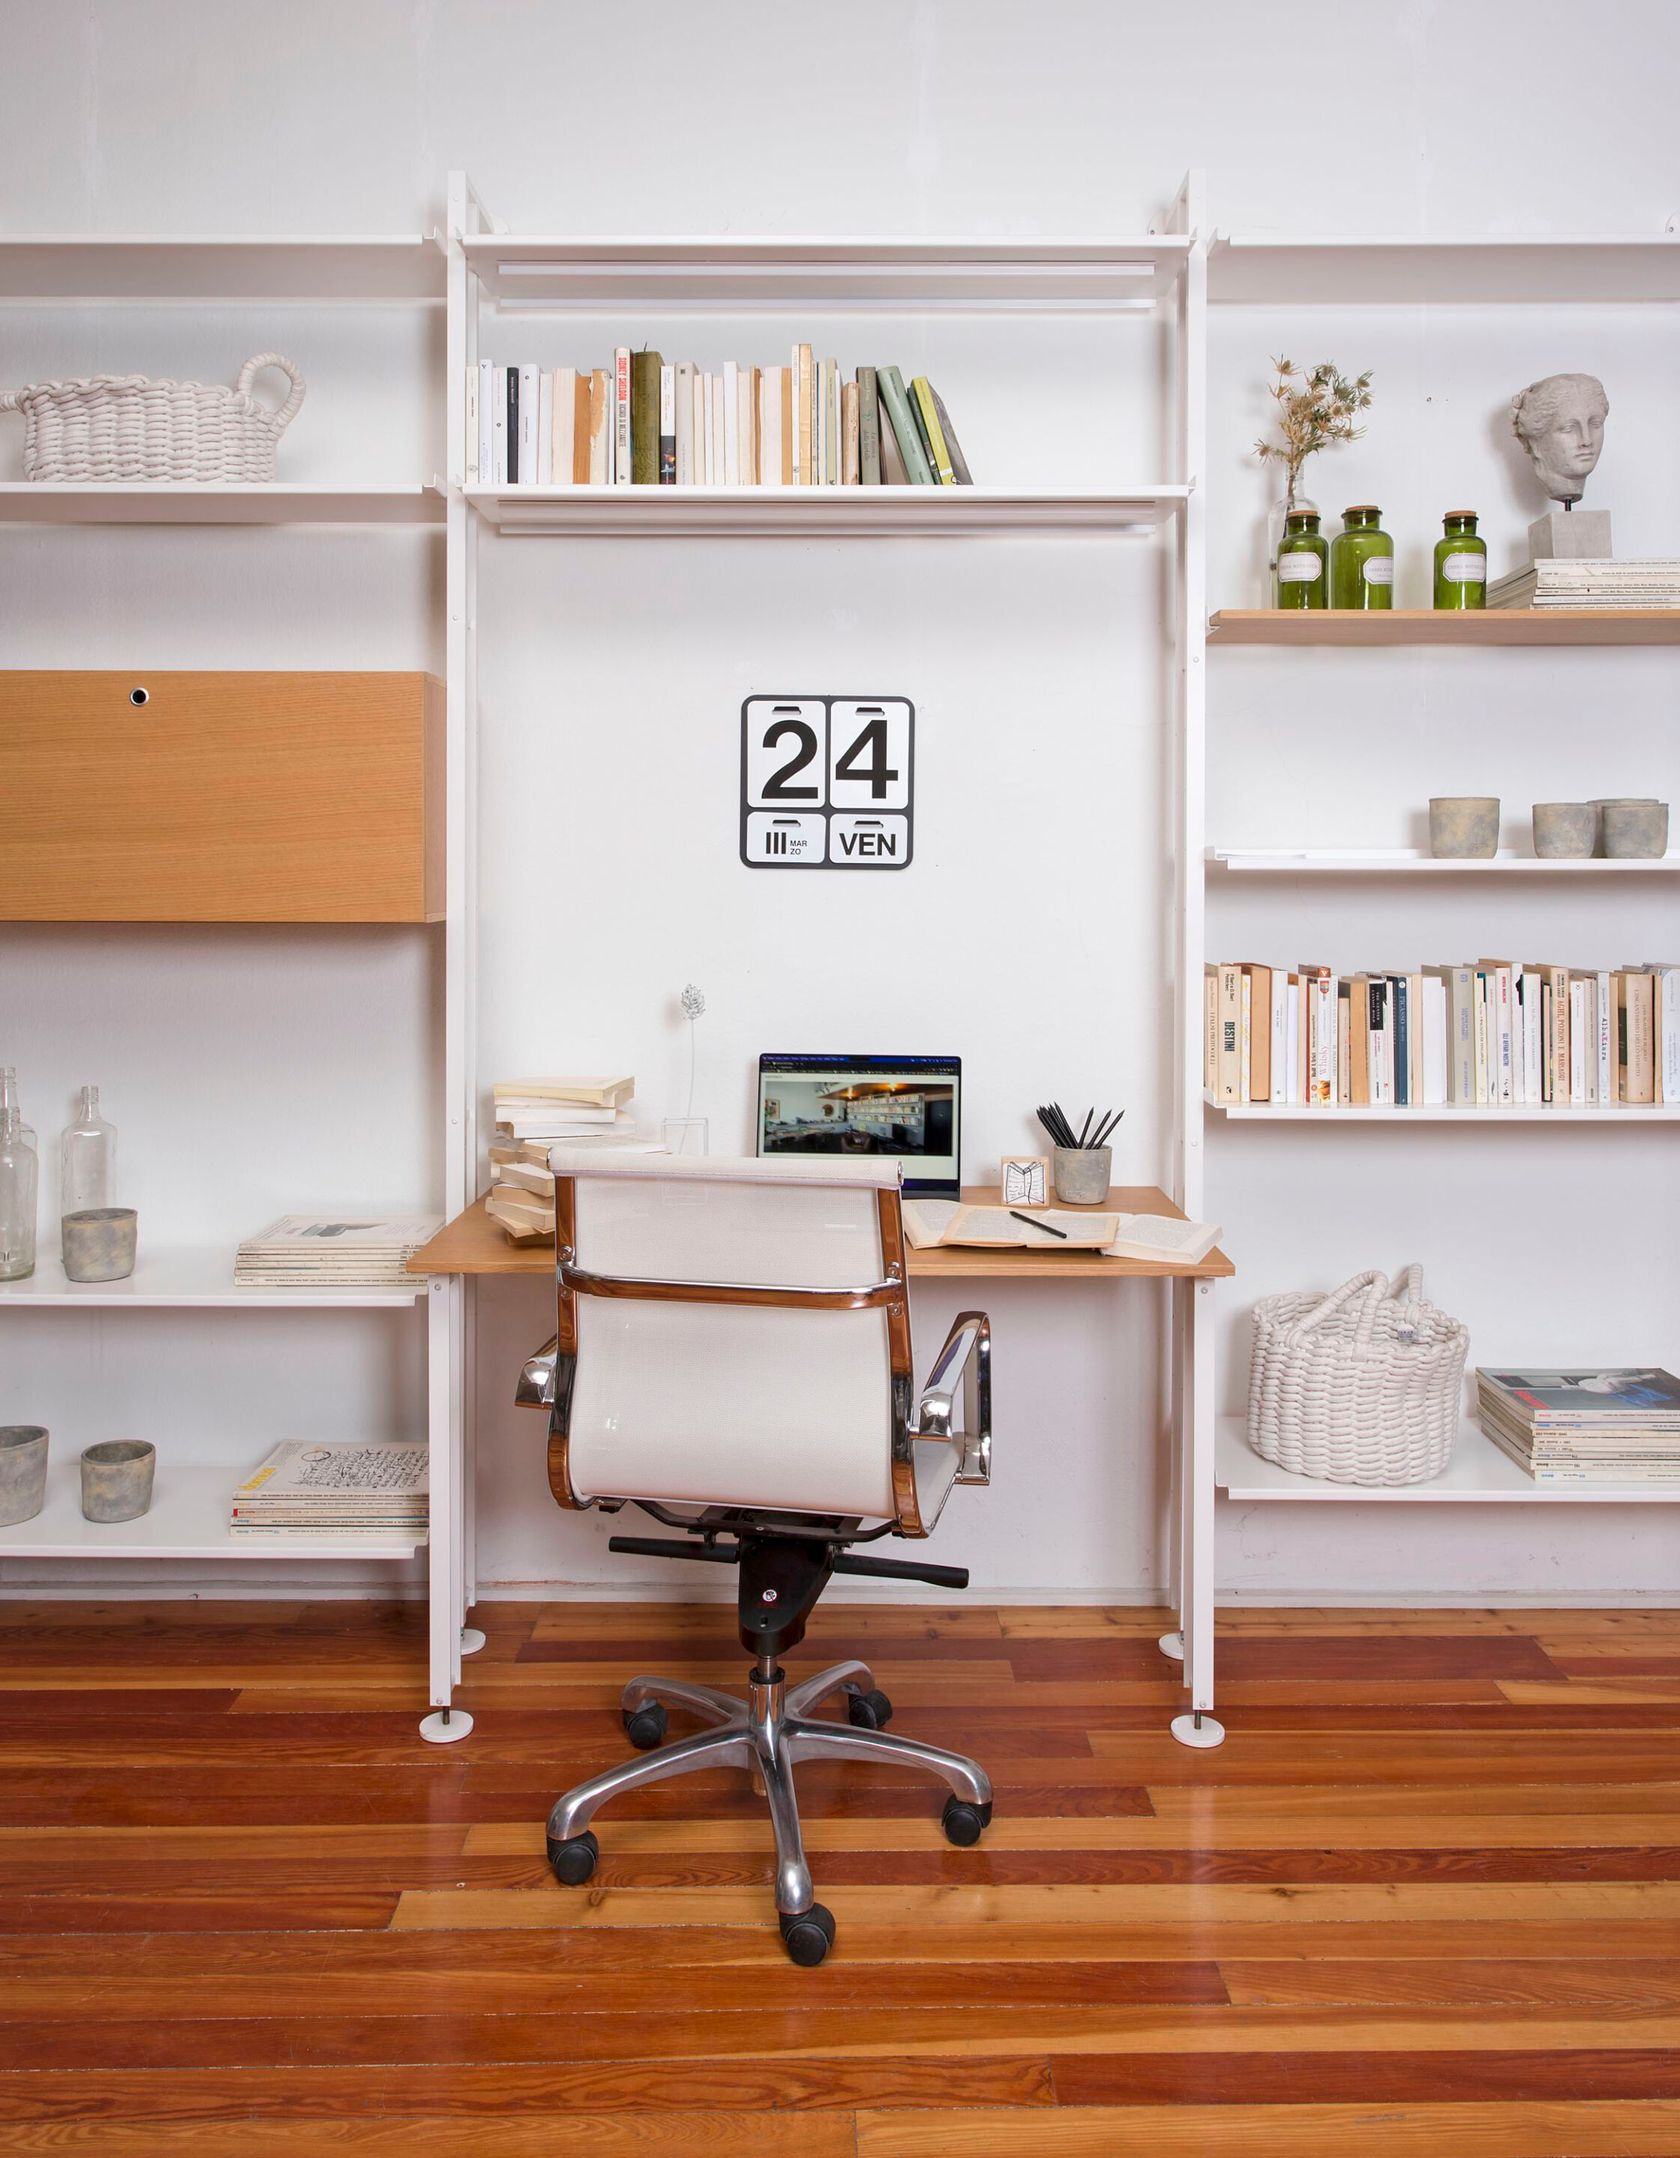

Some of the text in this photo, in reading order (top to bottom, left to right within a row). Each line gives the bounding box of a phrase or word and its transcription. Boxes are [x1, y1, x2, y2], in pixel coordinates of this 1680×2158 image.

[618, 357, 627, 376] SIDNEY
[618, 377, 627, 401] SHELDON
[839, 833, 896, 857] VEN
[1224, 1021, 1236, 1052] DESTINI
[1557, 1019, 1565, 1044] POZIONI
[1318, 1045, 1328, 1076] Whisky
